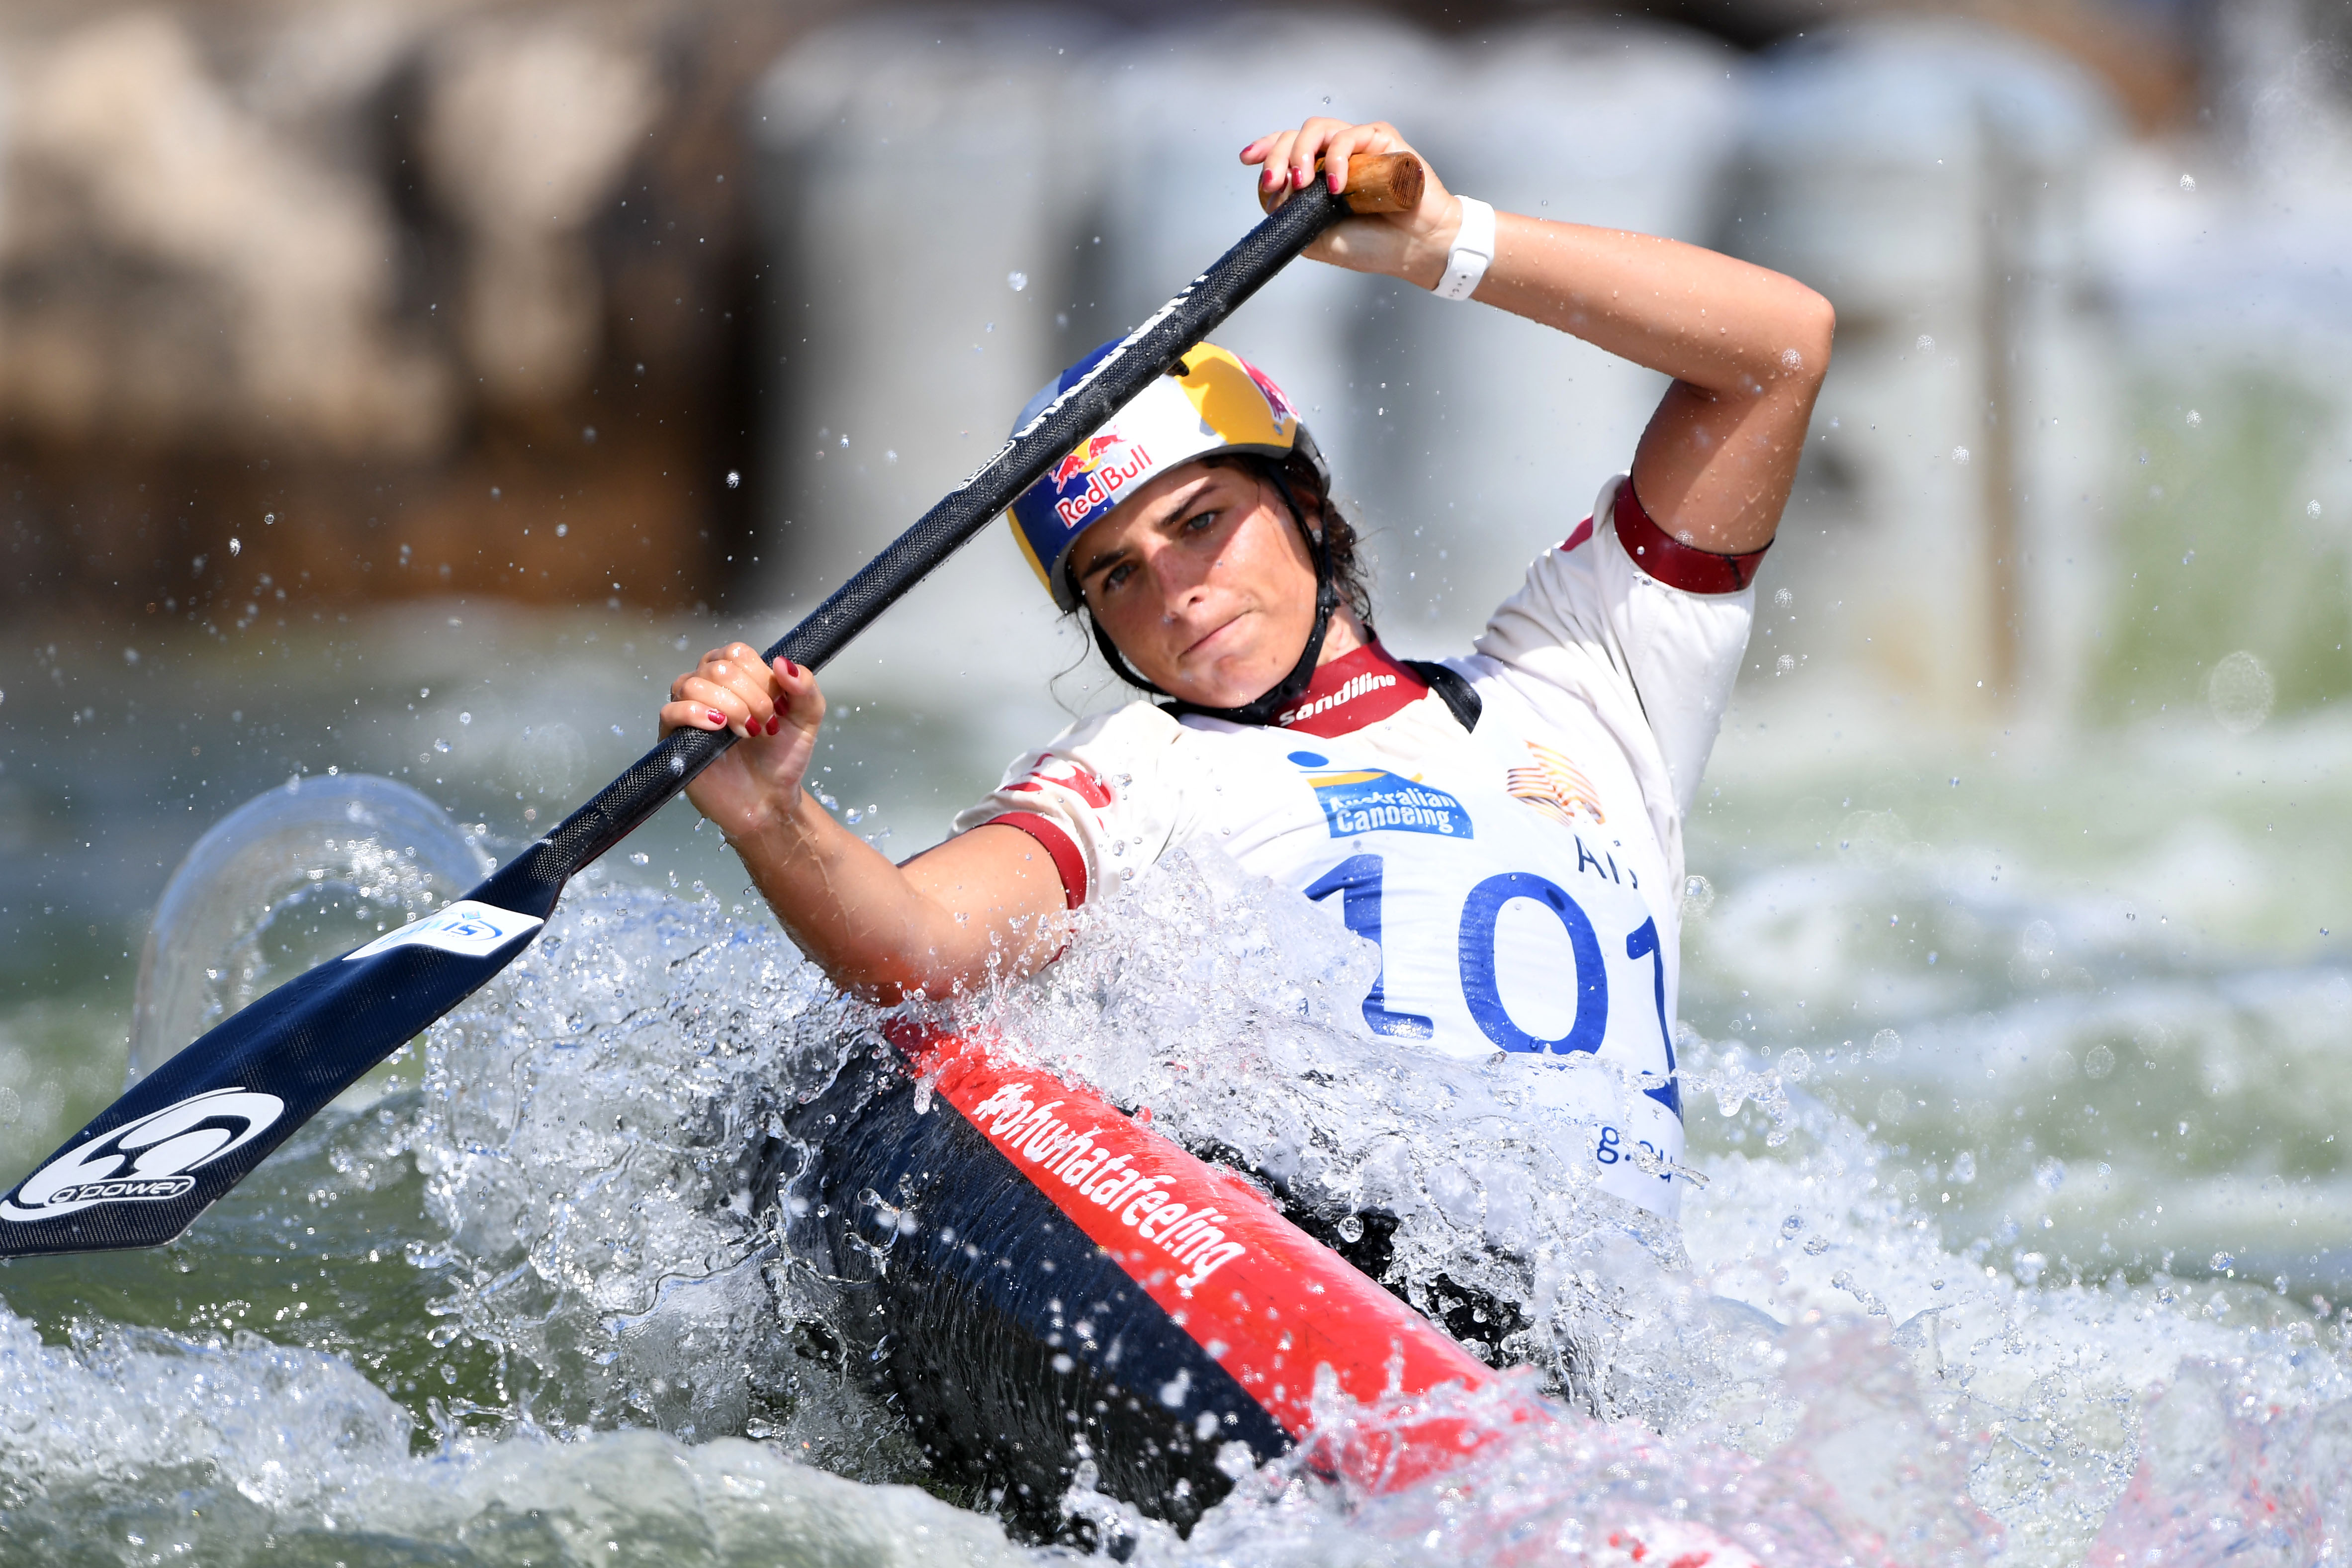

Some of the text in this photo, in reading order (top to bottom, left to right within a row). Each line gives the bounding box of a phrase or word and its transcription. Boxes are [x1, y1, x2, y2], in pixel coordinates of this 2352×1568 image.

[1057, 444, 1153, 527] Red Bull
[1279, 671, 1396, 727] sandiline
[1336, 805, 1454, 834] Canoeing
[1302, 853, 1684, 1126] 101
[970, 1082, 1246, 1289] #ohwhatafeeling
